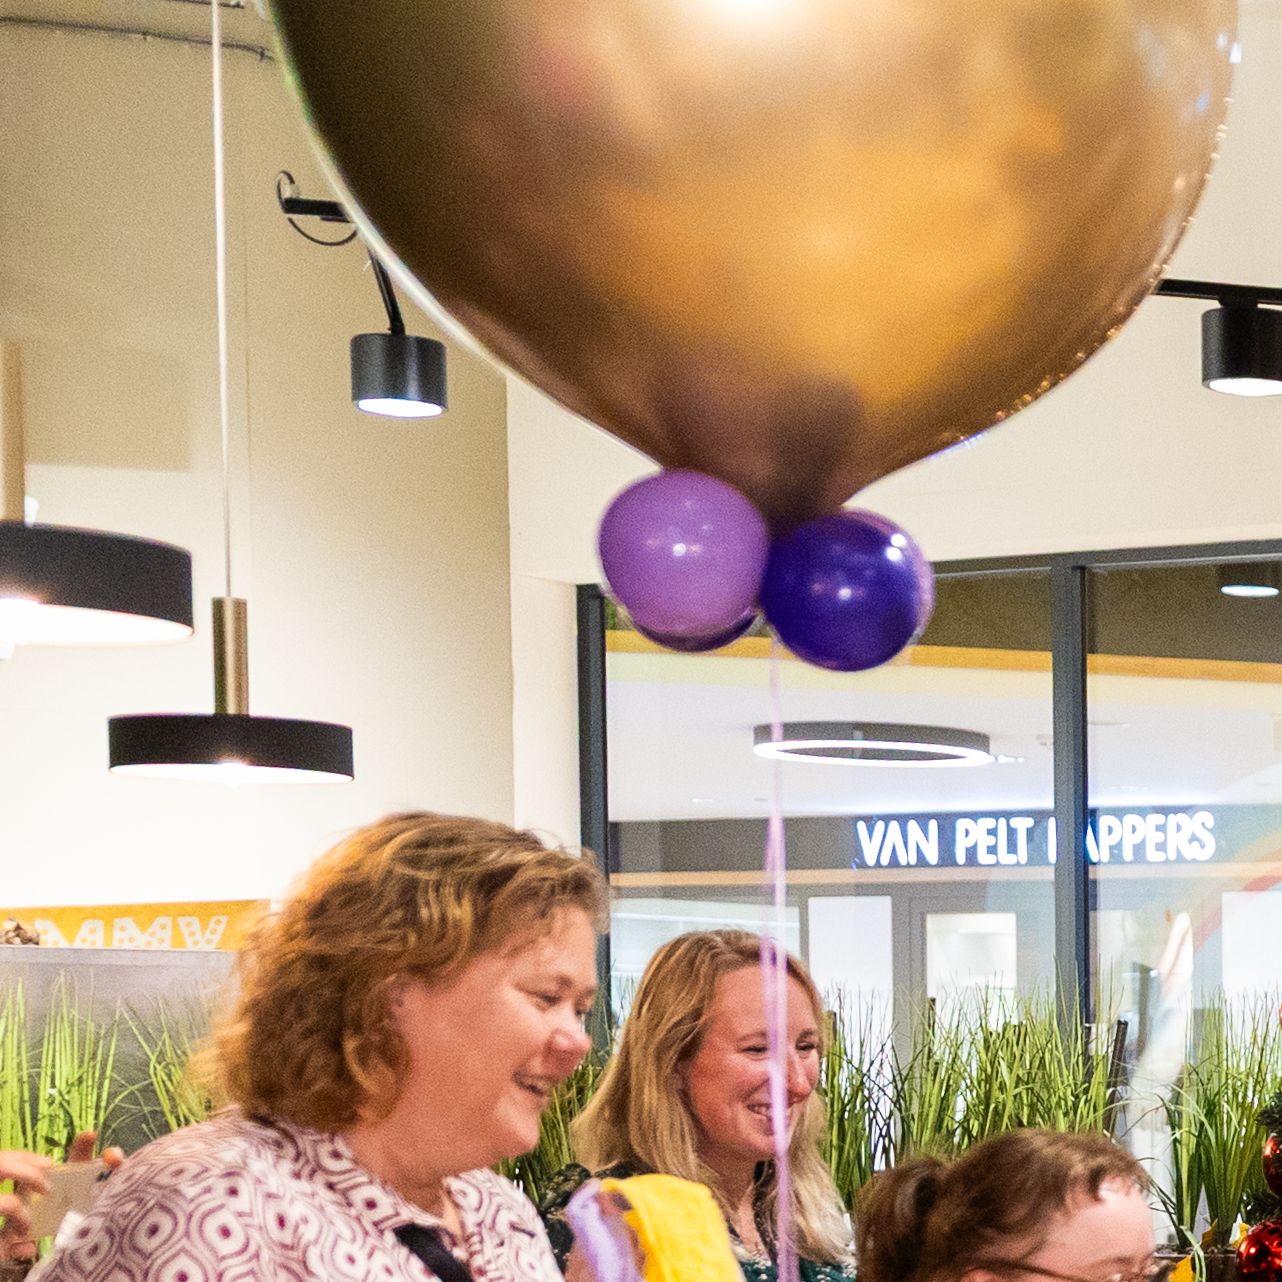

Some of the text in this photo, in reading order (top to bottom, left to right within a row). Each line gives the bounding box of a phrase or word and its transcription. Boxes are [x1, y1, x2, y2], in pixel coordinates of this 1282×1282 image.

[856, 810, 1216, 866] VAN PELT APPERS
